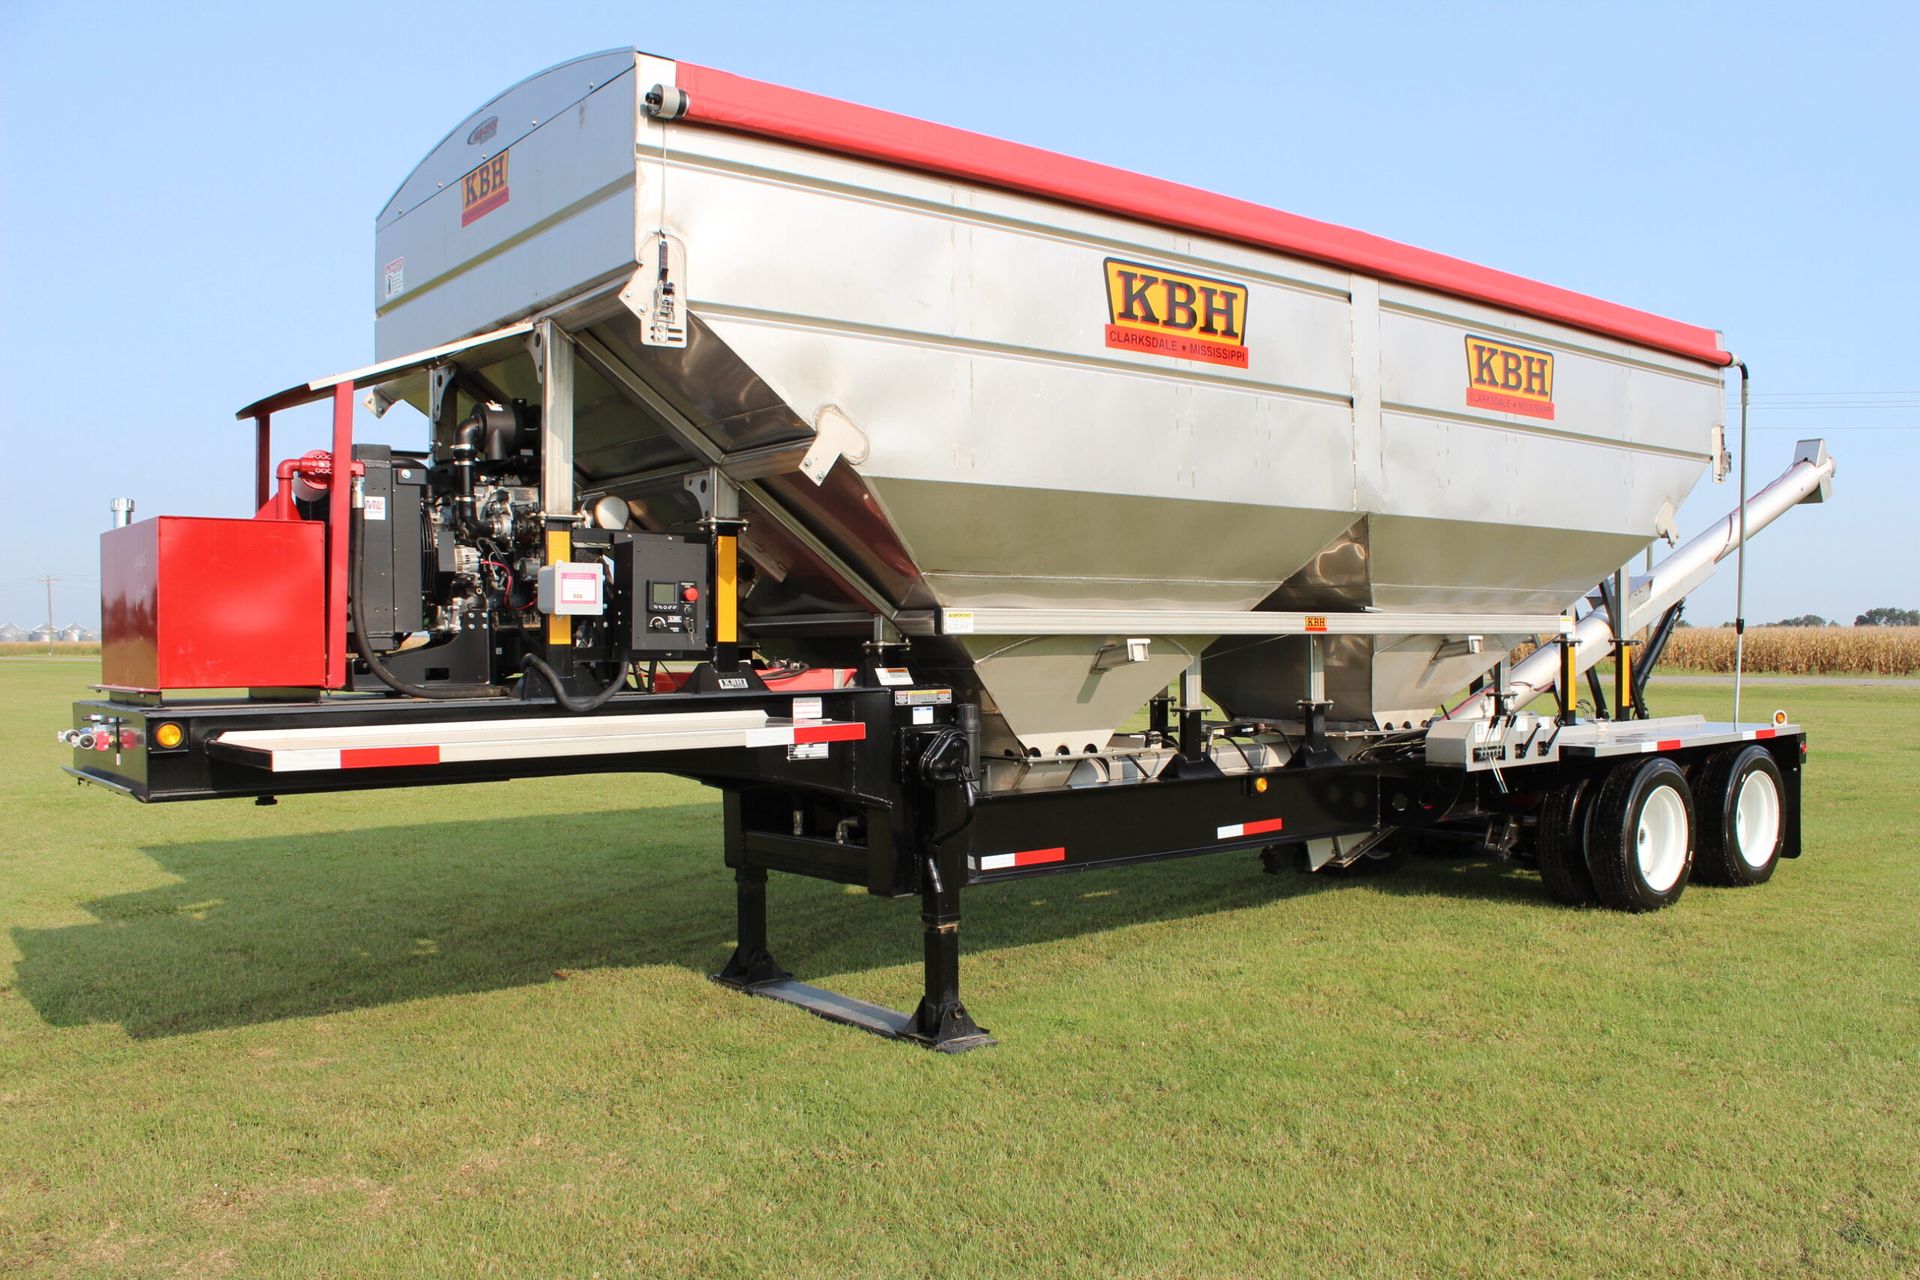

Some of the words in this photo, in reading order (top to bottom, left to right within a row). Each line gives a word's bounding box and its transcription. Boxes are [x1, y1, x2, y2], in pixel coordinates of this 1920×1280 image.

[465, 155, 505, 208] KBH
[1117, 270, 1239, 339] KBH
[1109, 330, 1177, 351] CLARKSDALE
[1190, 343, 1245, 362] MISSISSIPPI
[1472, 344, 1548, 397] KBH
[1307, 617, 1325, 627] KBH
